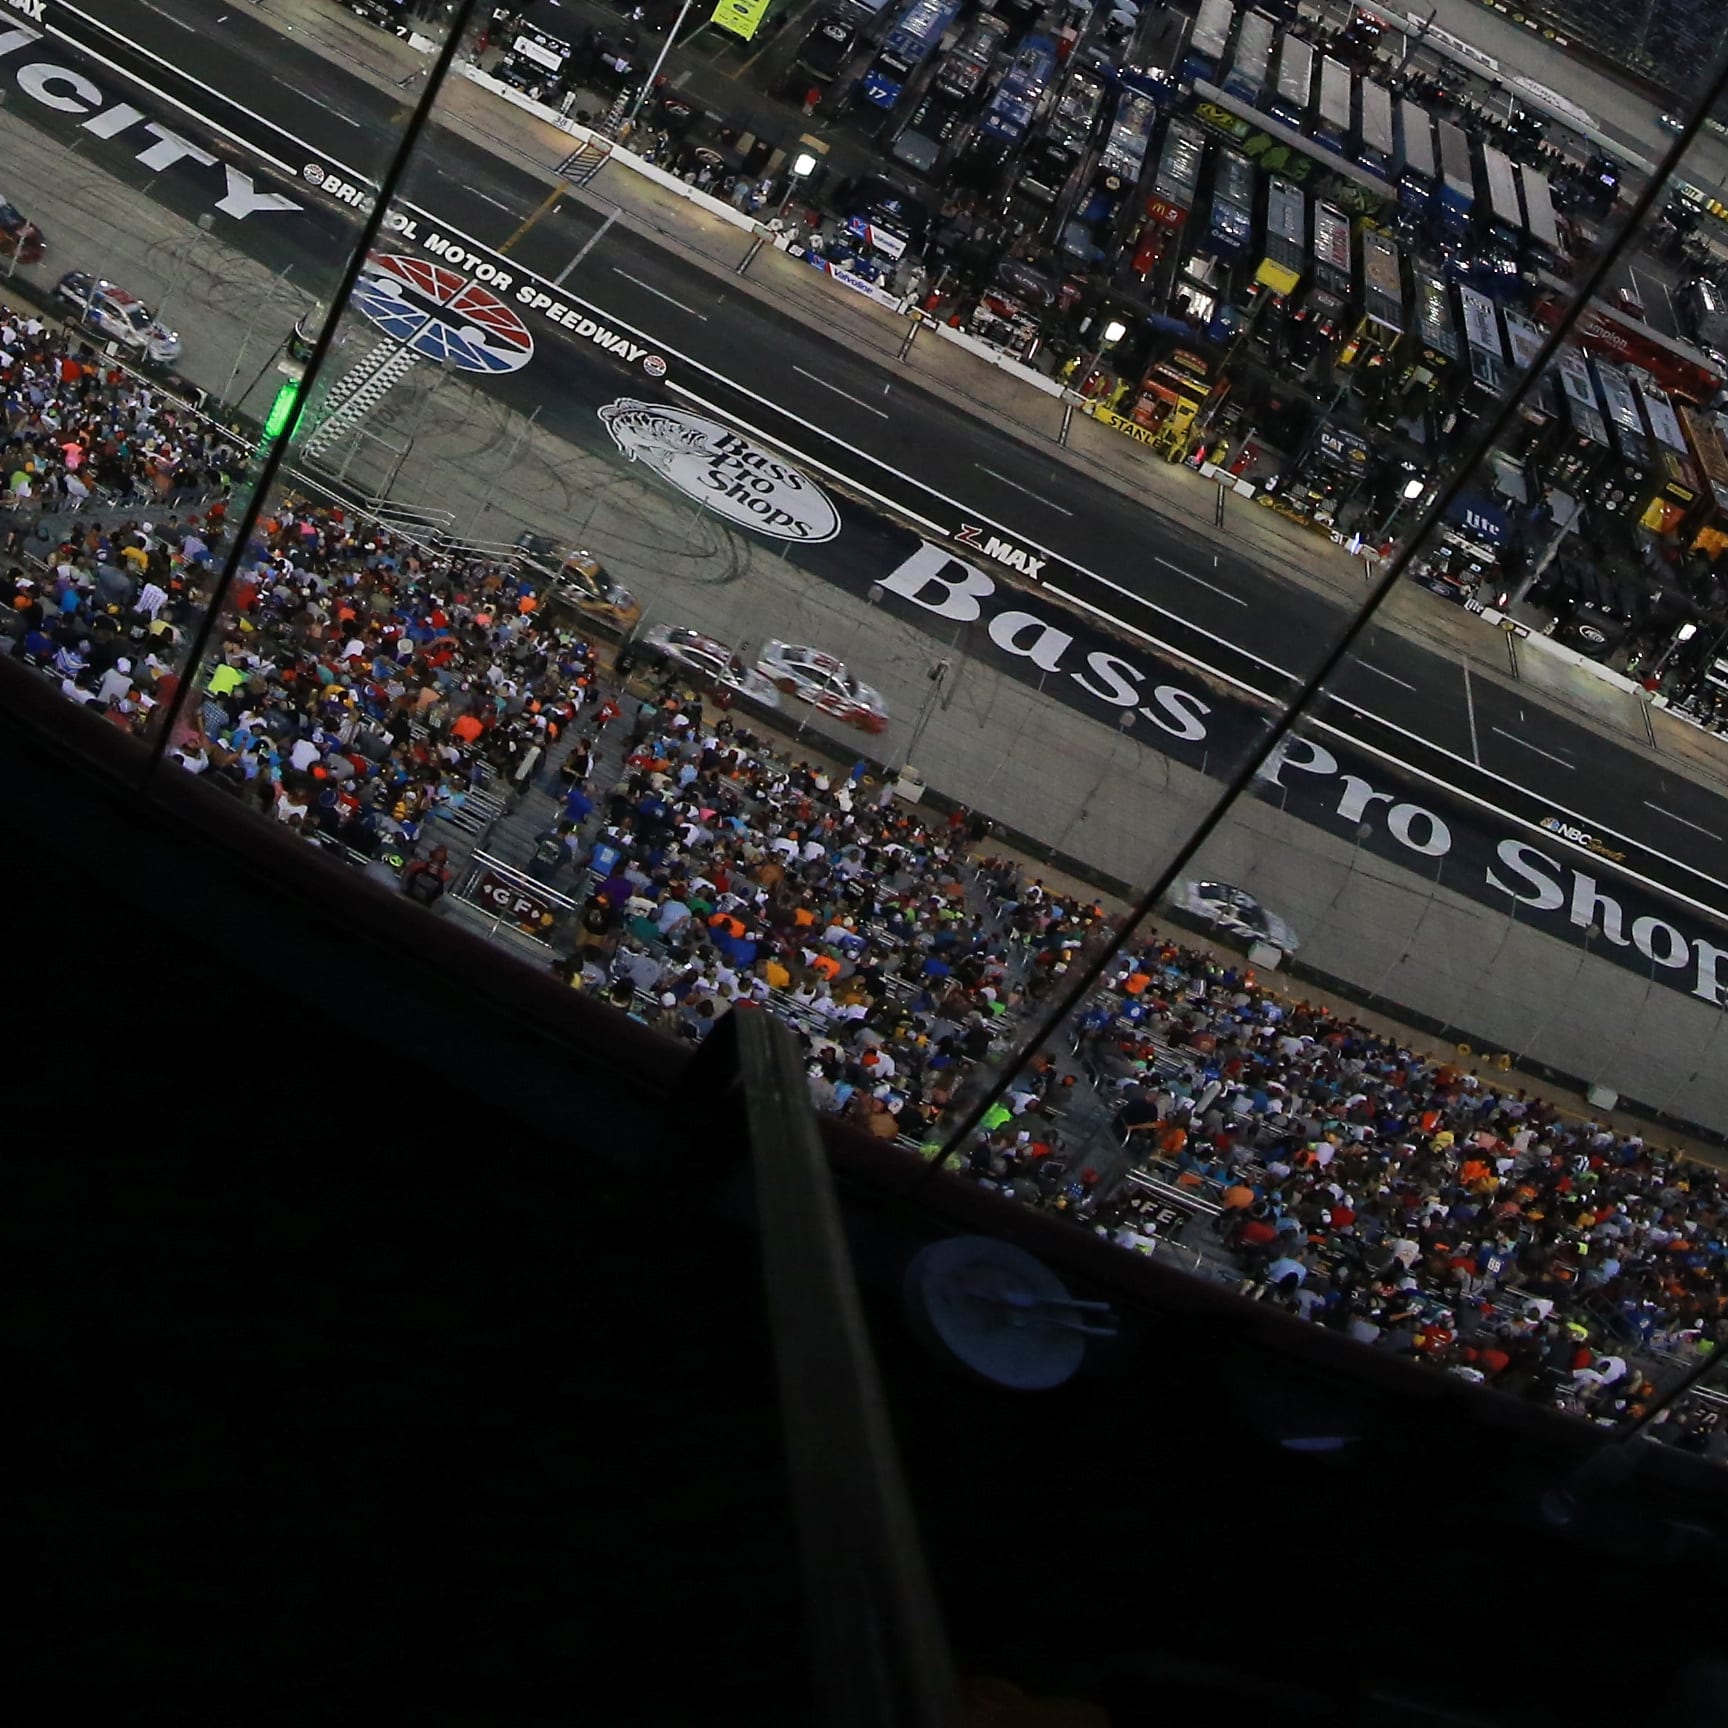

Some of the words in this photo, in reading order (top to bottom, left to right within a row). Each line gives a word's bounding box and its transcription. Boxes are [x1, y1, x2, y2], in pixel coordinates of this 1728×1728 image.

[868, 86, 888, 100] 17
[16, 62, 304, 221] CITY
[423, 232, 513, 292] MOTOR
[515, 285, 648, 364] SPEEDWAY
[833, 267, 874, 295] Valvoline
[713, 432, 805, 490] Bass
[1321, 432, 1345, 454] CAT
[708, 452, 775, 494] Pro
[697, 470, 813, 537] Shops
[873, 541, 1212, 743] Bass
[1253, 715, 1453, 857] Pro
[1558, 823, 1593, 846] NBC
